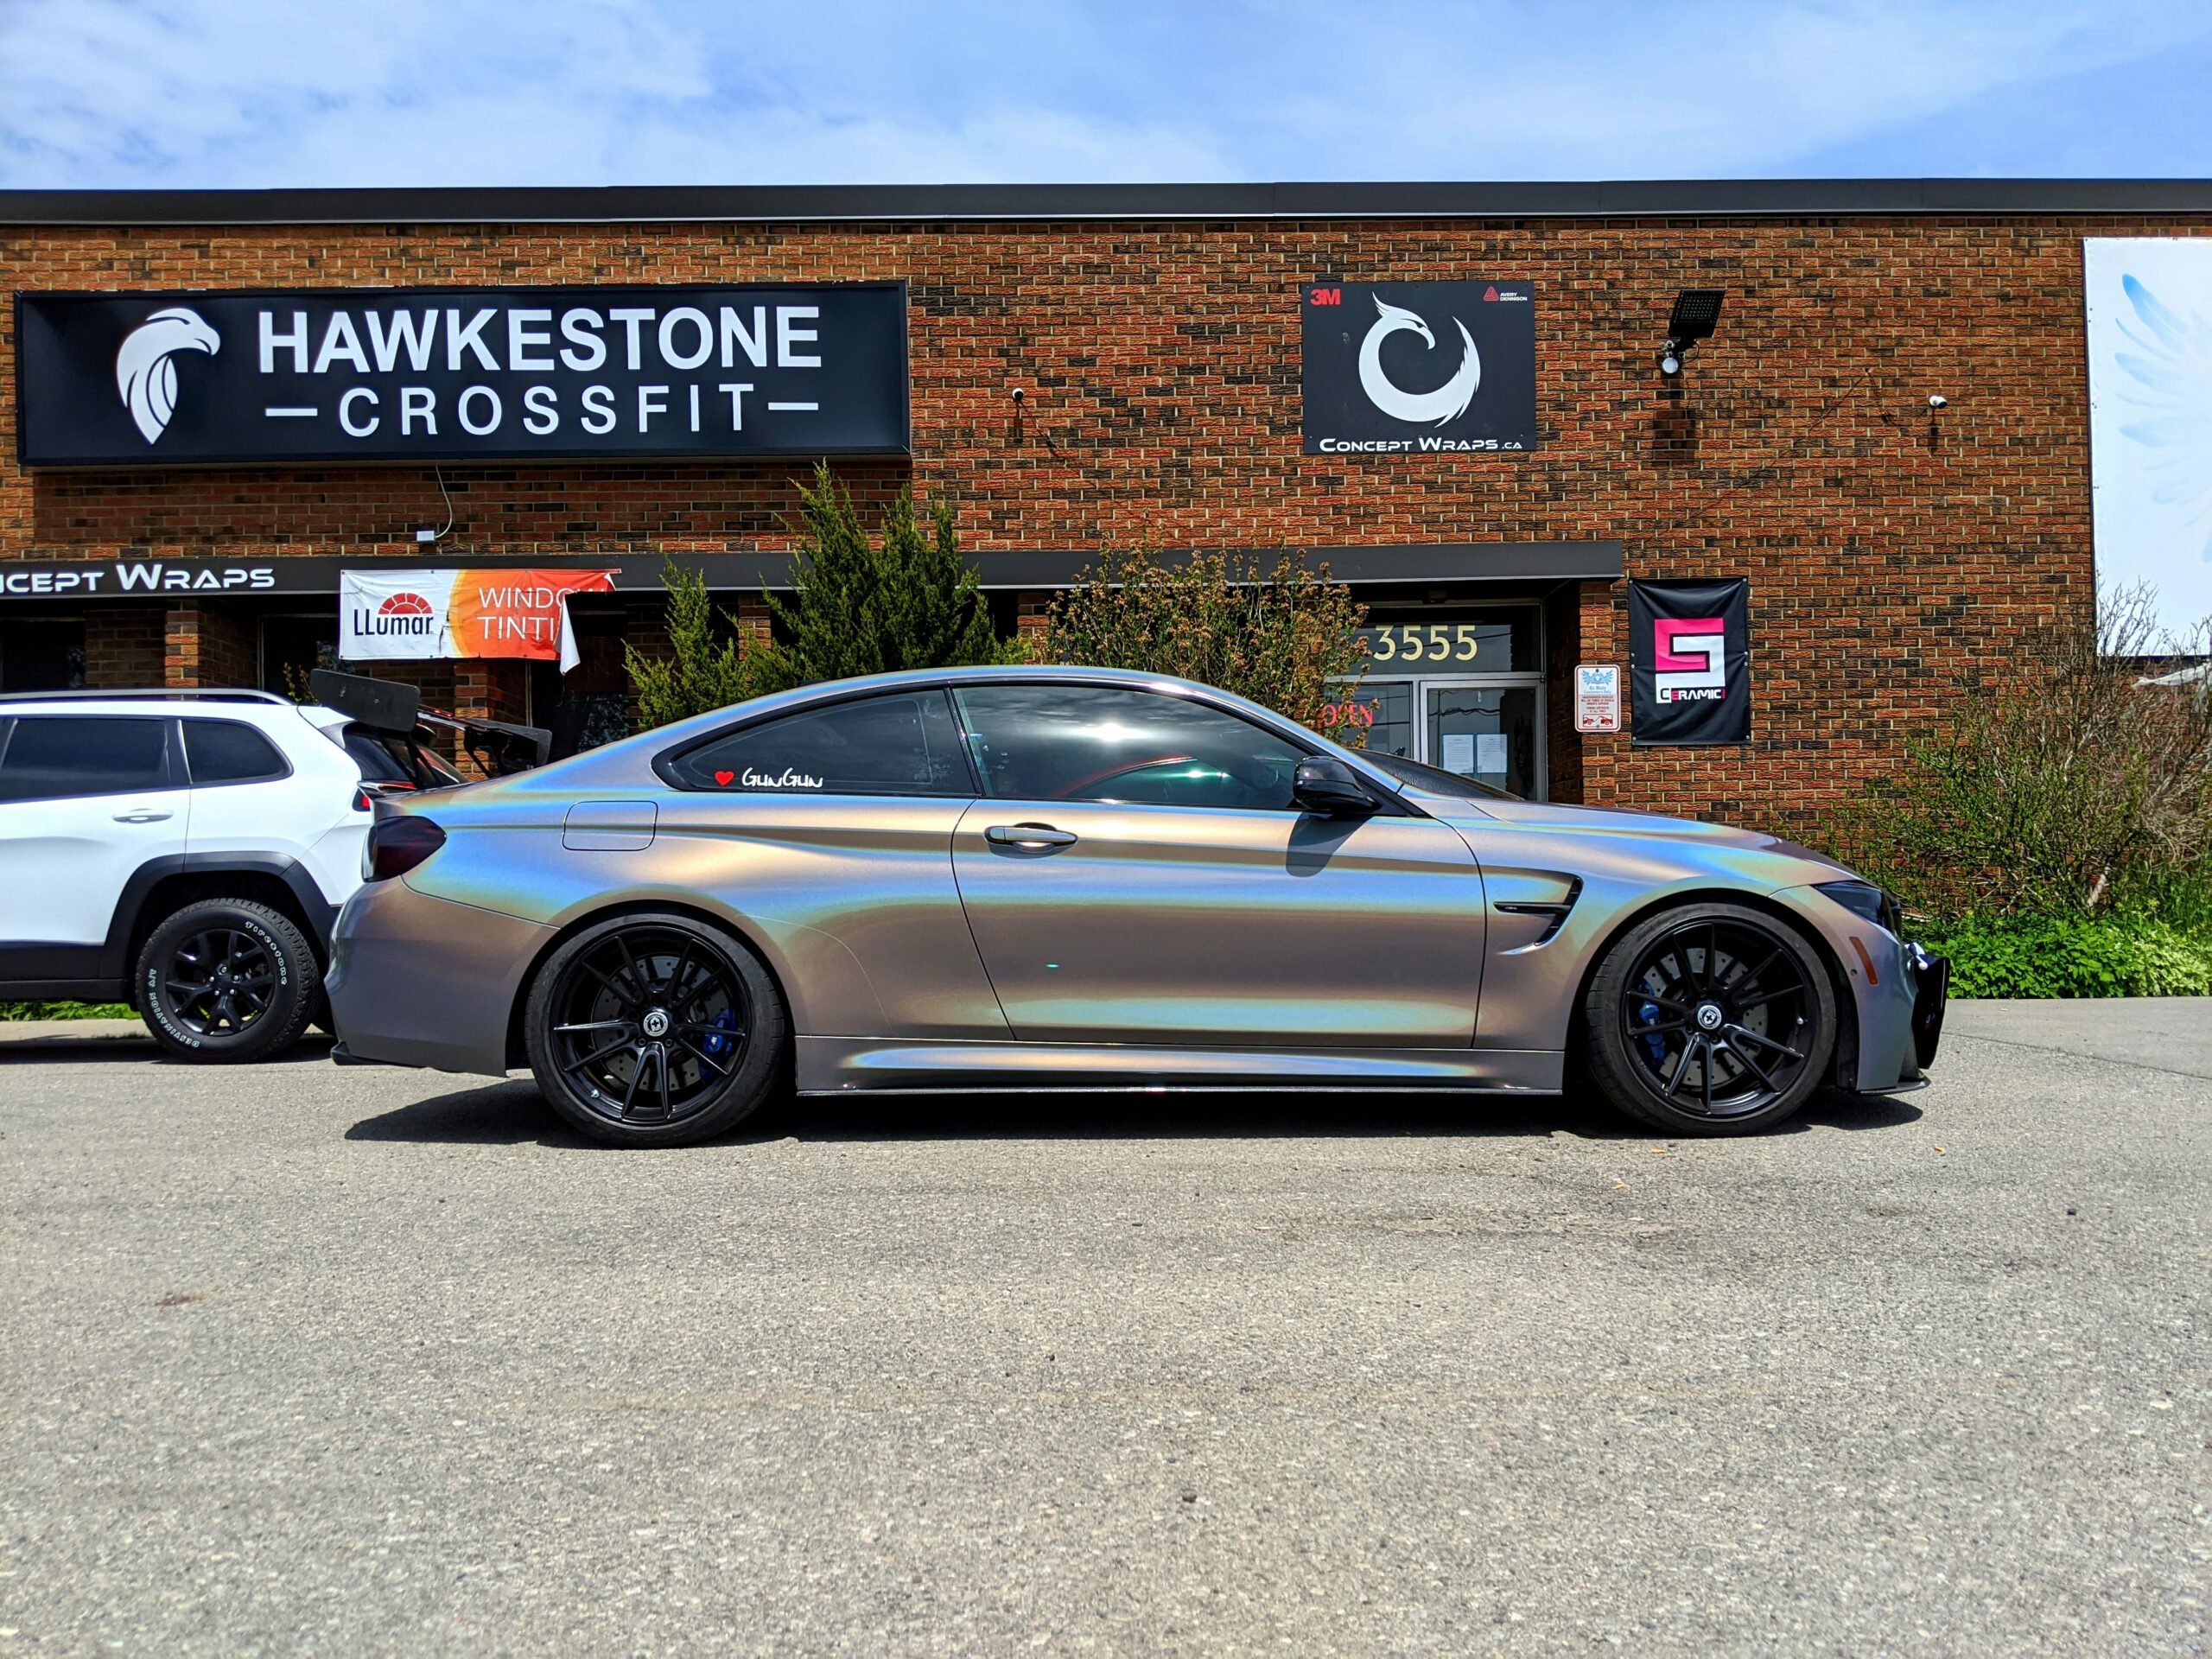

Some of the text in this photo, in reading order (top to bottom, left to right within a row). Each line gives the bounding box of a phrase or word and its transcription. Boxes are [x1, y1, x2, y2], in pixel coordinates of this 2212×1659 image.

[1310, 288, 1341, 306] 3M
[258, 305, 822, 374] HAWKESTONE
[339, 383, 754, 437] CROSSFIT
[0, 571, 105, 594] CEPT
[1372, 624, 1478, 661] 3555
[1660, 688, 1722, 702] CERAMIC
[1322, 704, 1374, 727] OEN
[149, 992, 200, 1047] DESTINATION
